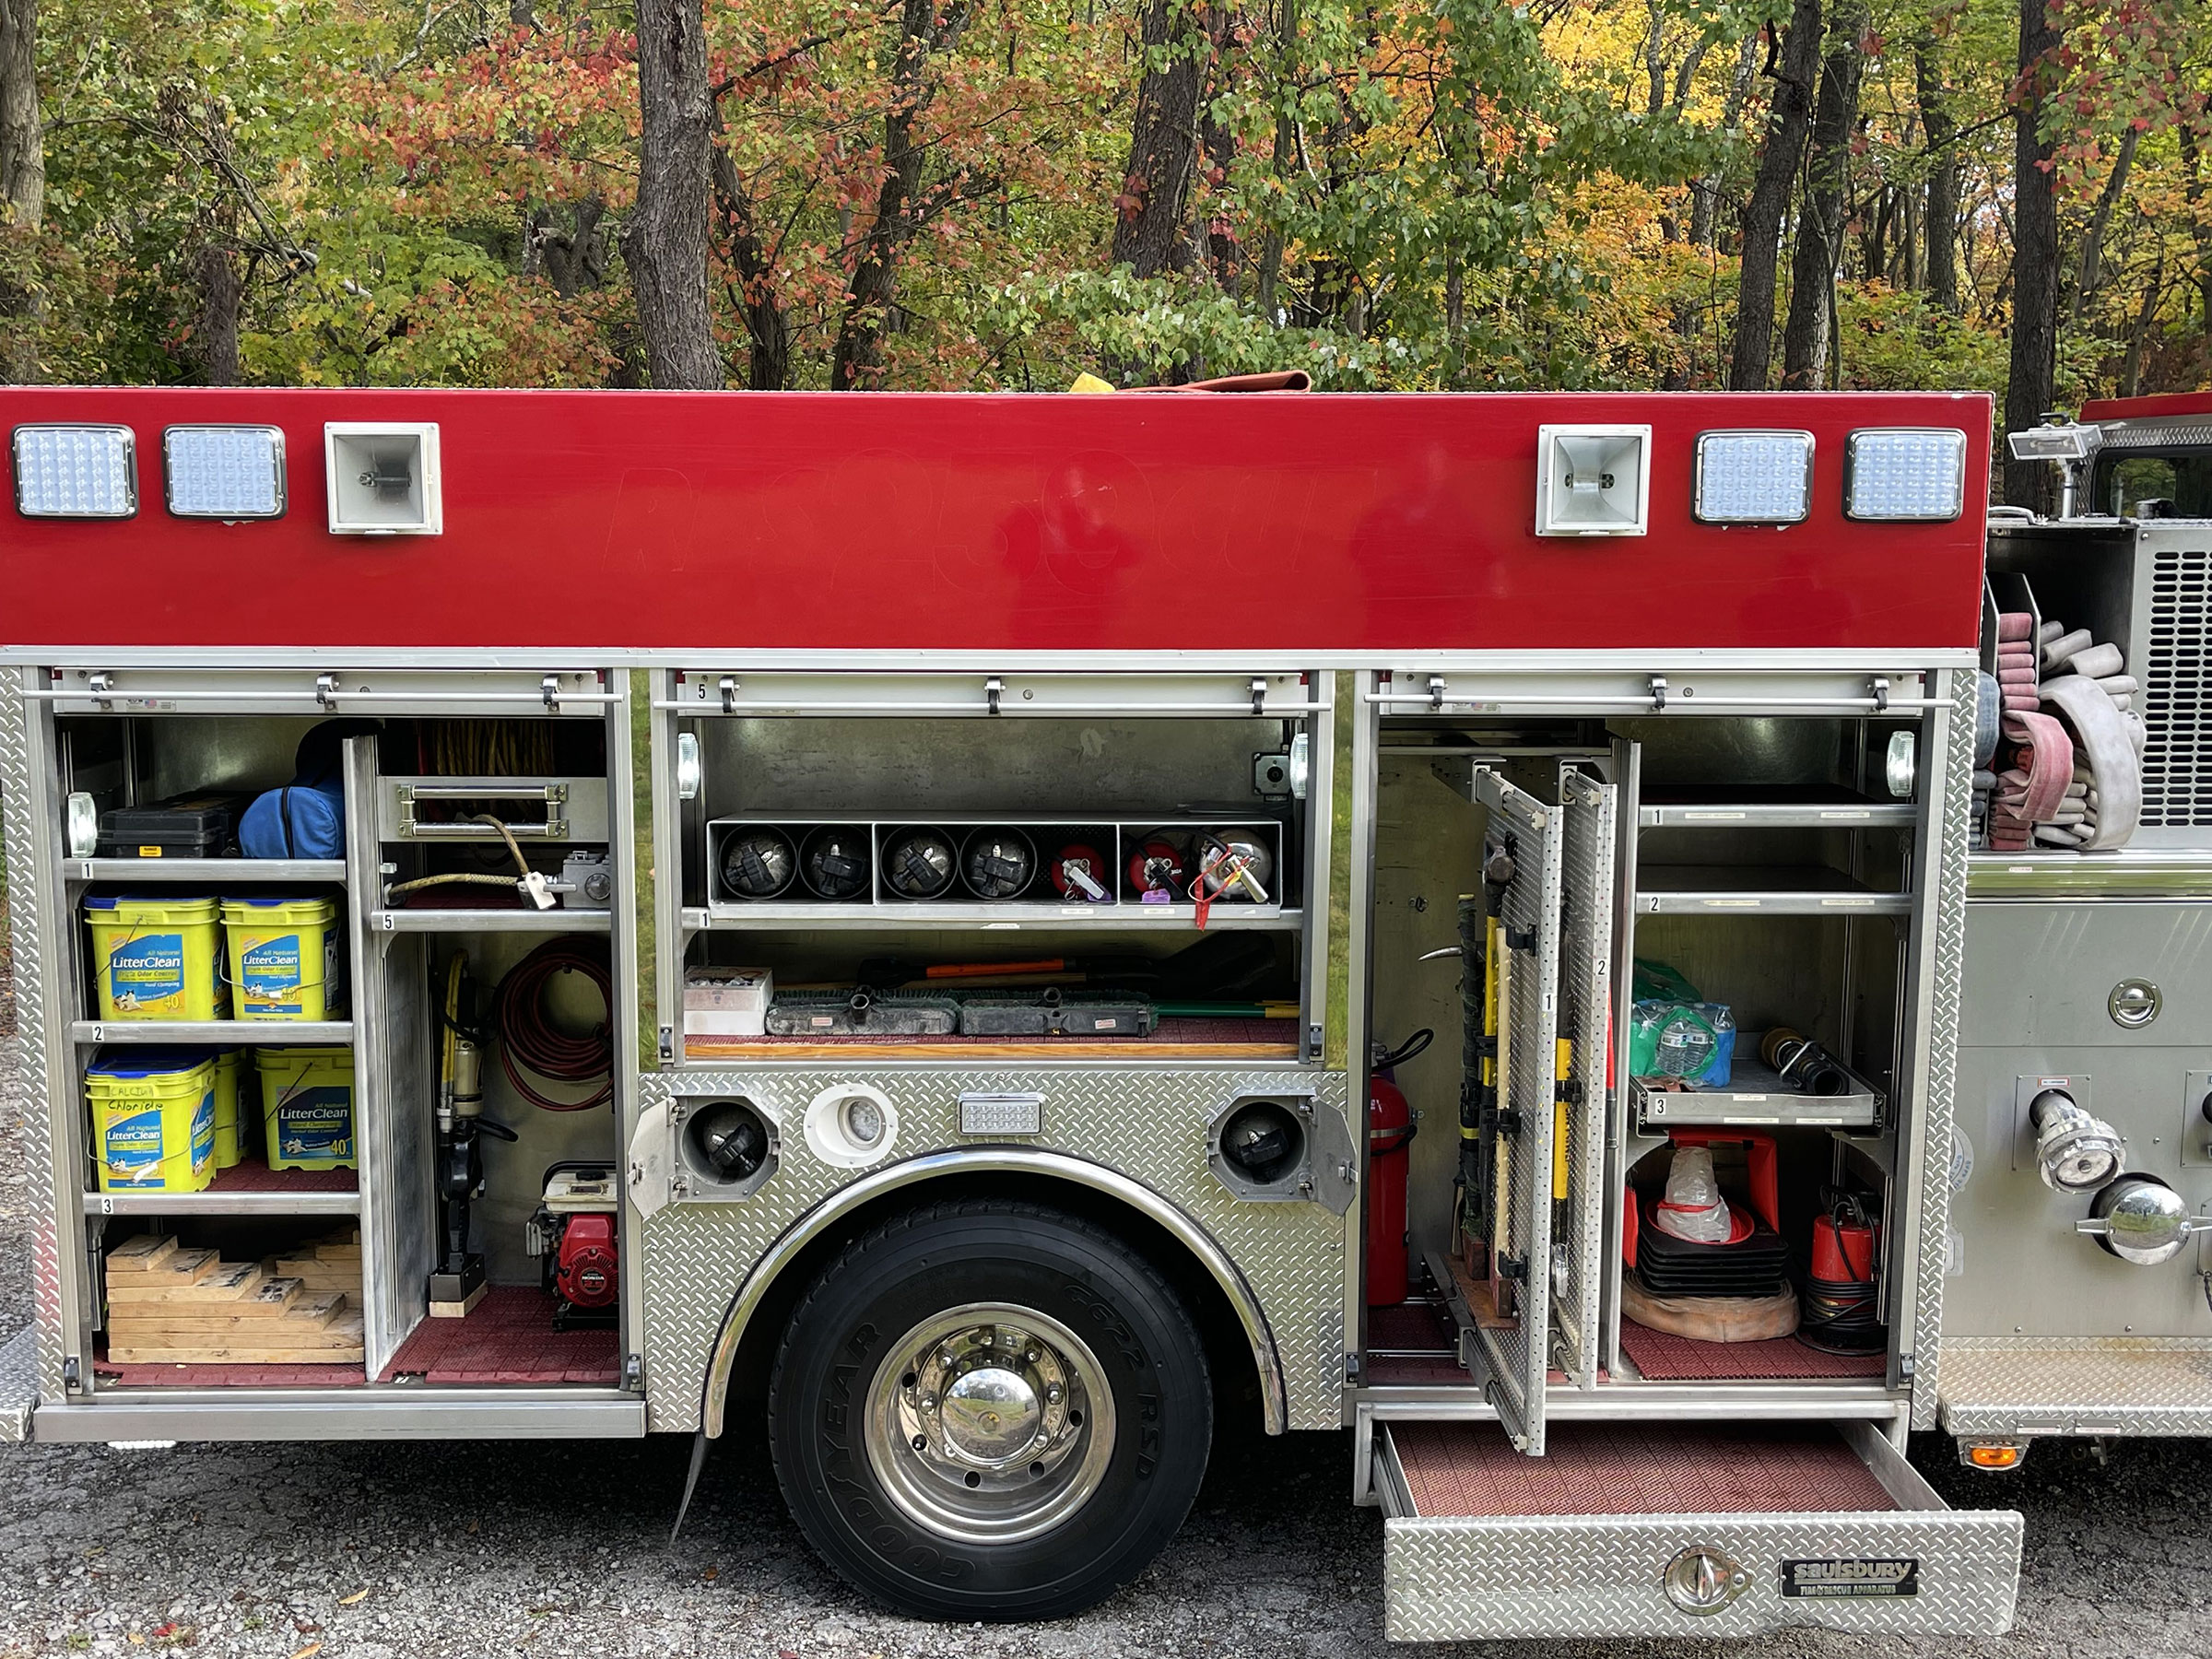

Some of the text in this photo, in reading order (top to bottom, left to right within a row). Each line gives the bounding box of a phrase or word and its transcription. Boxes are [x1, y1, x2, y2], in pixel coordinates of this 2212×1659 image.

[699, 684, 706, 699] 5
[1655, 809, 1660, 823] 1
[85, 863, 90, 877] 1
[1651, 897, 1658, 911] 2
[385, 914, 392, 929] 5
[703, 912, 708, 926] 1
[112, 957, 181, 969] LitterClean
[243, 956, 298, 965] LitterClean
[1599, 960, 1607, 975] 2
[1547, 994, 1552, 1010] 1
[95, 1026, 102, 1041] 2
[108, 1100, 164, 1112] Chloride
[1657, 1100, 1665, 1113] 3
[280, 1108, 347, 1119] LitterClean
[107, 1131, 160, 1140] LitterClean
[332, 1139, 347, 1155] 40
[104, 1198, 112, 1213] 3
[1063, 1284, 1159, 1480] G622 RSD
[823, 1322, 976, 1577] GOODYEAR
